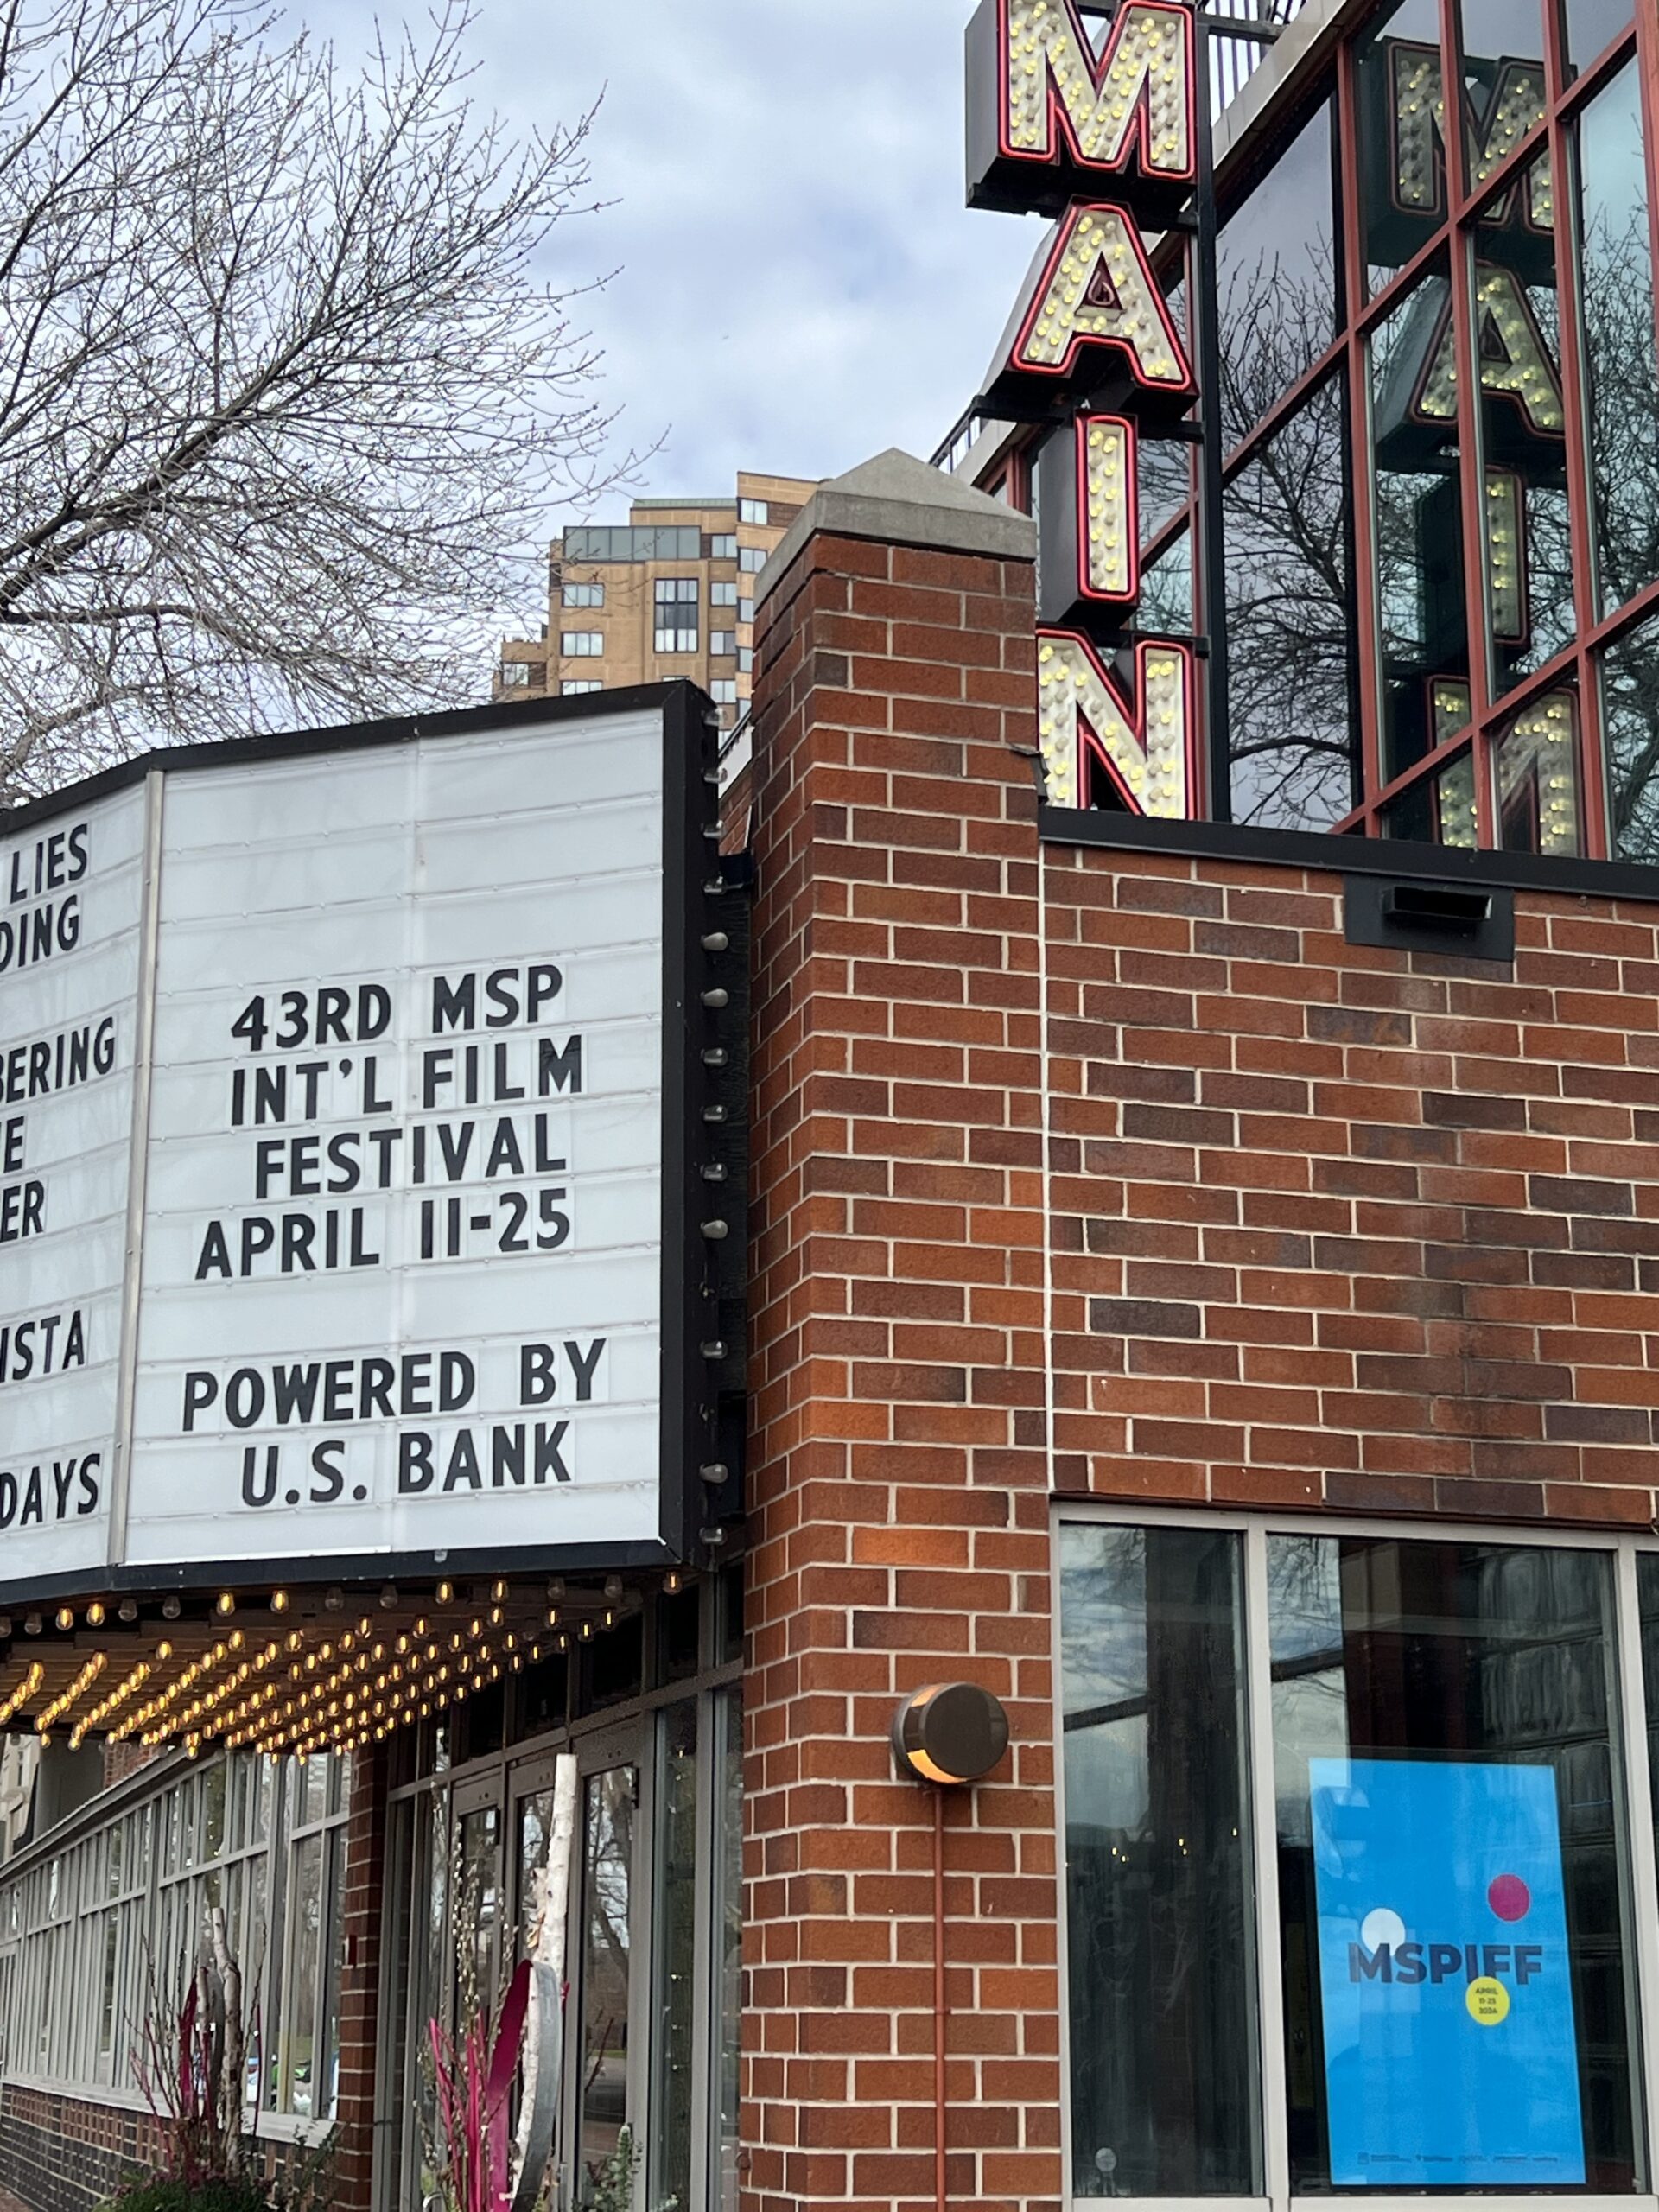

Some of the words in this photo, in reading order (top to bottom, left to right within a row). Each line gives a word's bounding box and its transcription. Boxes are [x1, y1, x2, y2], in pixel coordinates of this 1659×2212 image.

[996, 0, 1198, 821] MAIN
[10, 823, 88, 905] LIES
[231, 984, 391, 1052] 43RD
[432, 964, 563, 1033] MSP
[0, 1016, 115, 1103] ERING
[423, 1034, 582, 1109] FILM
[0, 1116, 25, 1173] E
[256, 1113, 567, 1199] FESTIVAL
[195, 1207, 381, 1280] APRIL
[182, 1351, 475, 1432] POWERED
[520, 1338, 607, 1407] BY
[0, 1453, 101, 1529] DAYS
[242, 1440, 368, 1508] U.S.
[398, 1420, 572, 1495] BANK
[1348, 1942, 1542, 1986] MSPIFF
